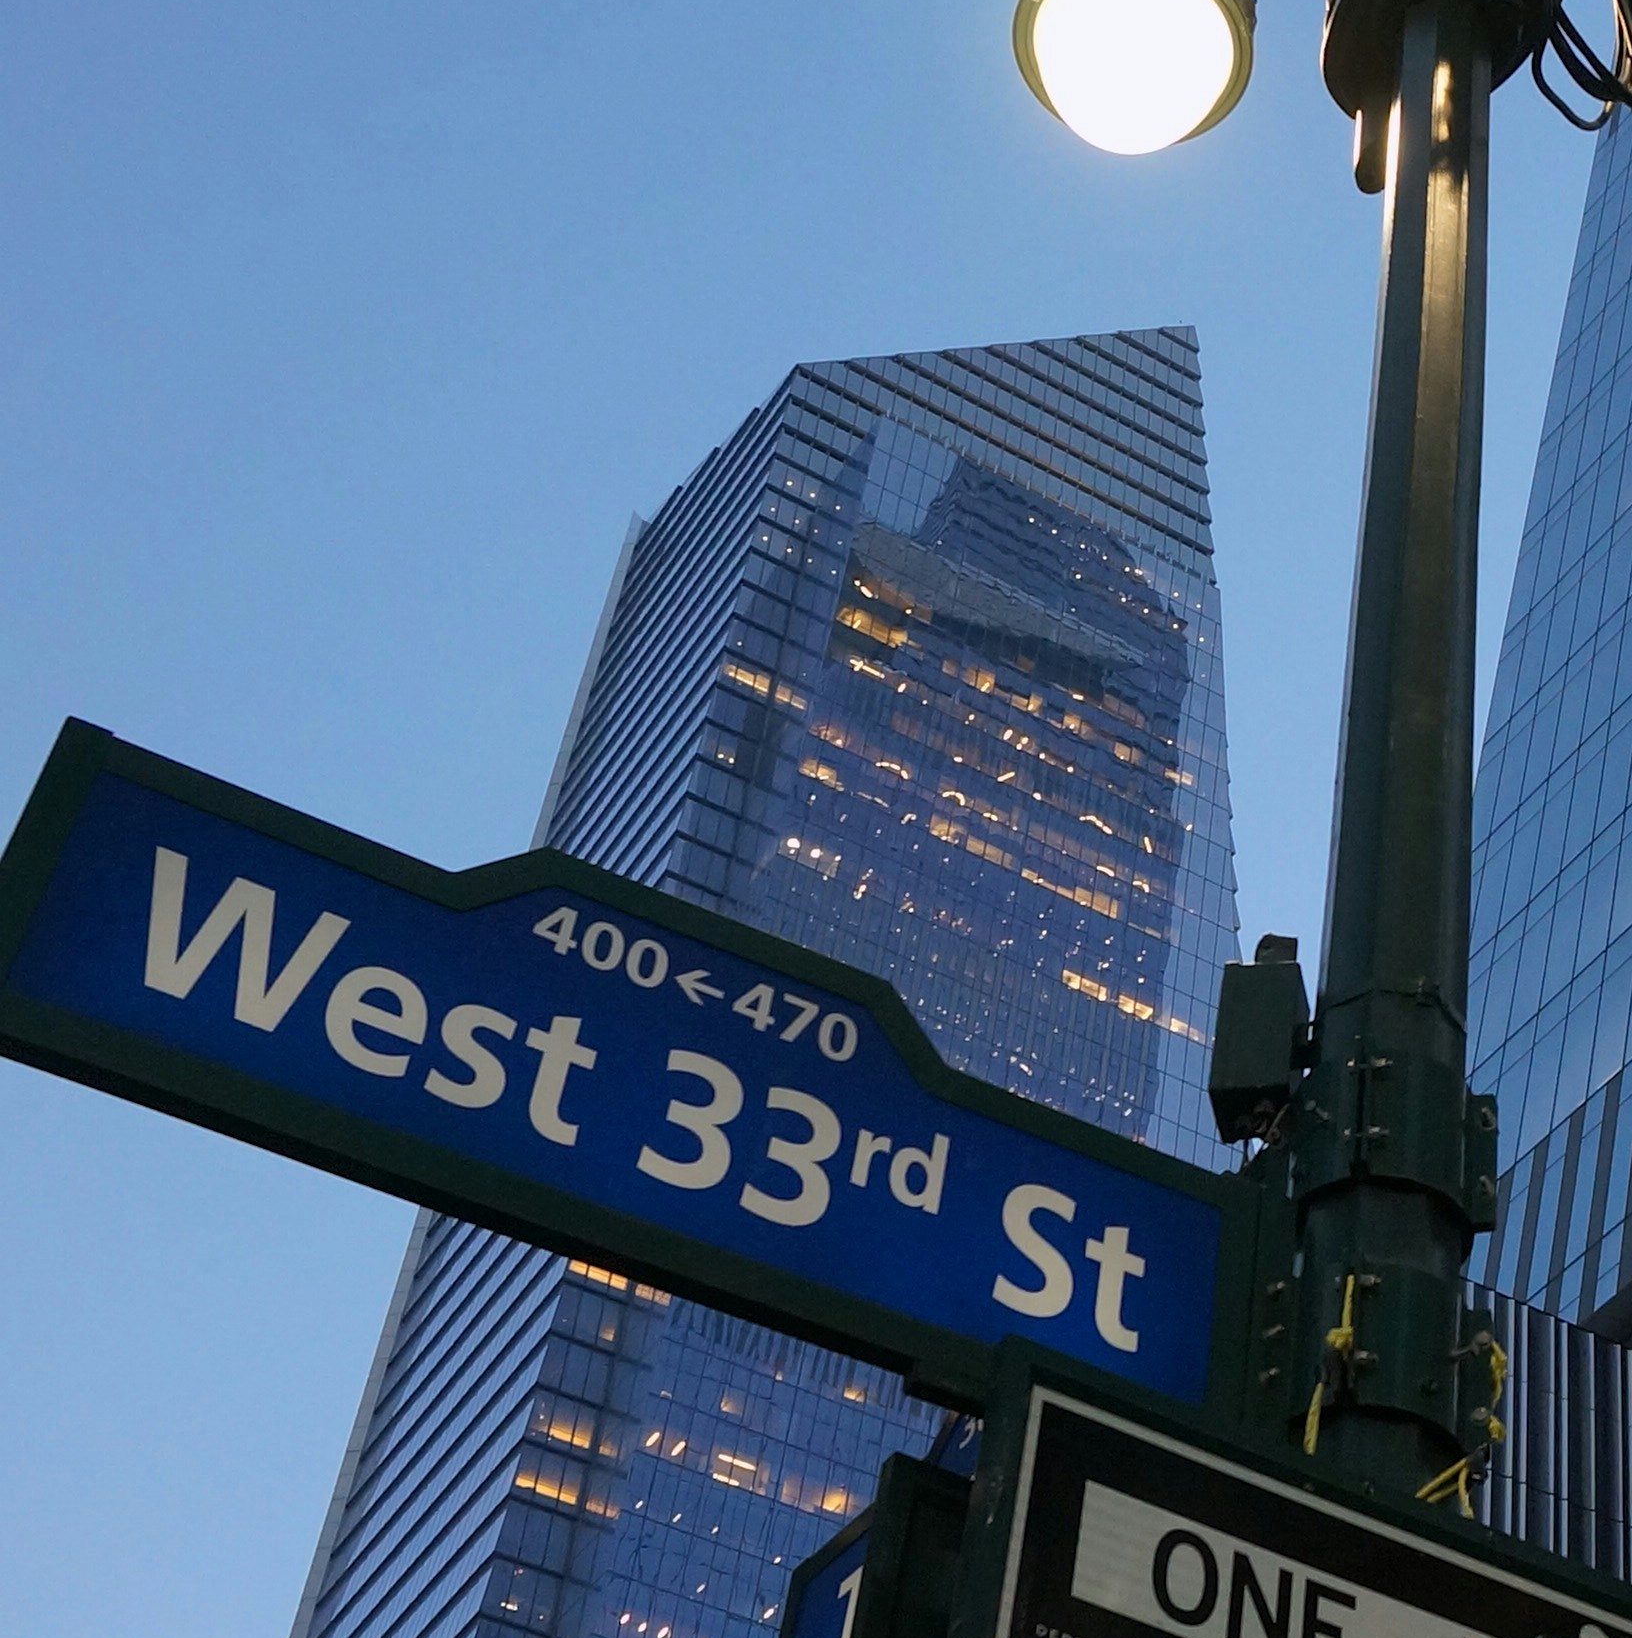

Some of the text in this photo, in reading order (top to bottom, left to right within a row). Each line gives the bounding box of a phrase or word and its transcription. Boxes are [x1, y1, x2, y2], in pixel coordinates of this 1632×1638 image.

[143, 845, 1147, 1354] West 33rd St
[533, 906, 858, 1061] 400 470
